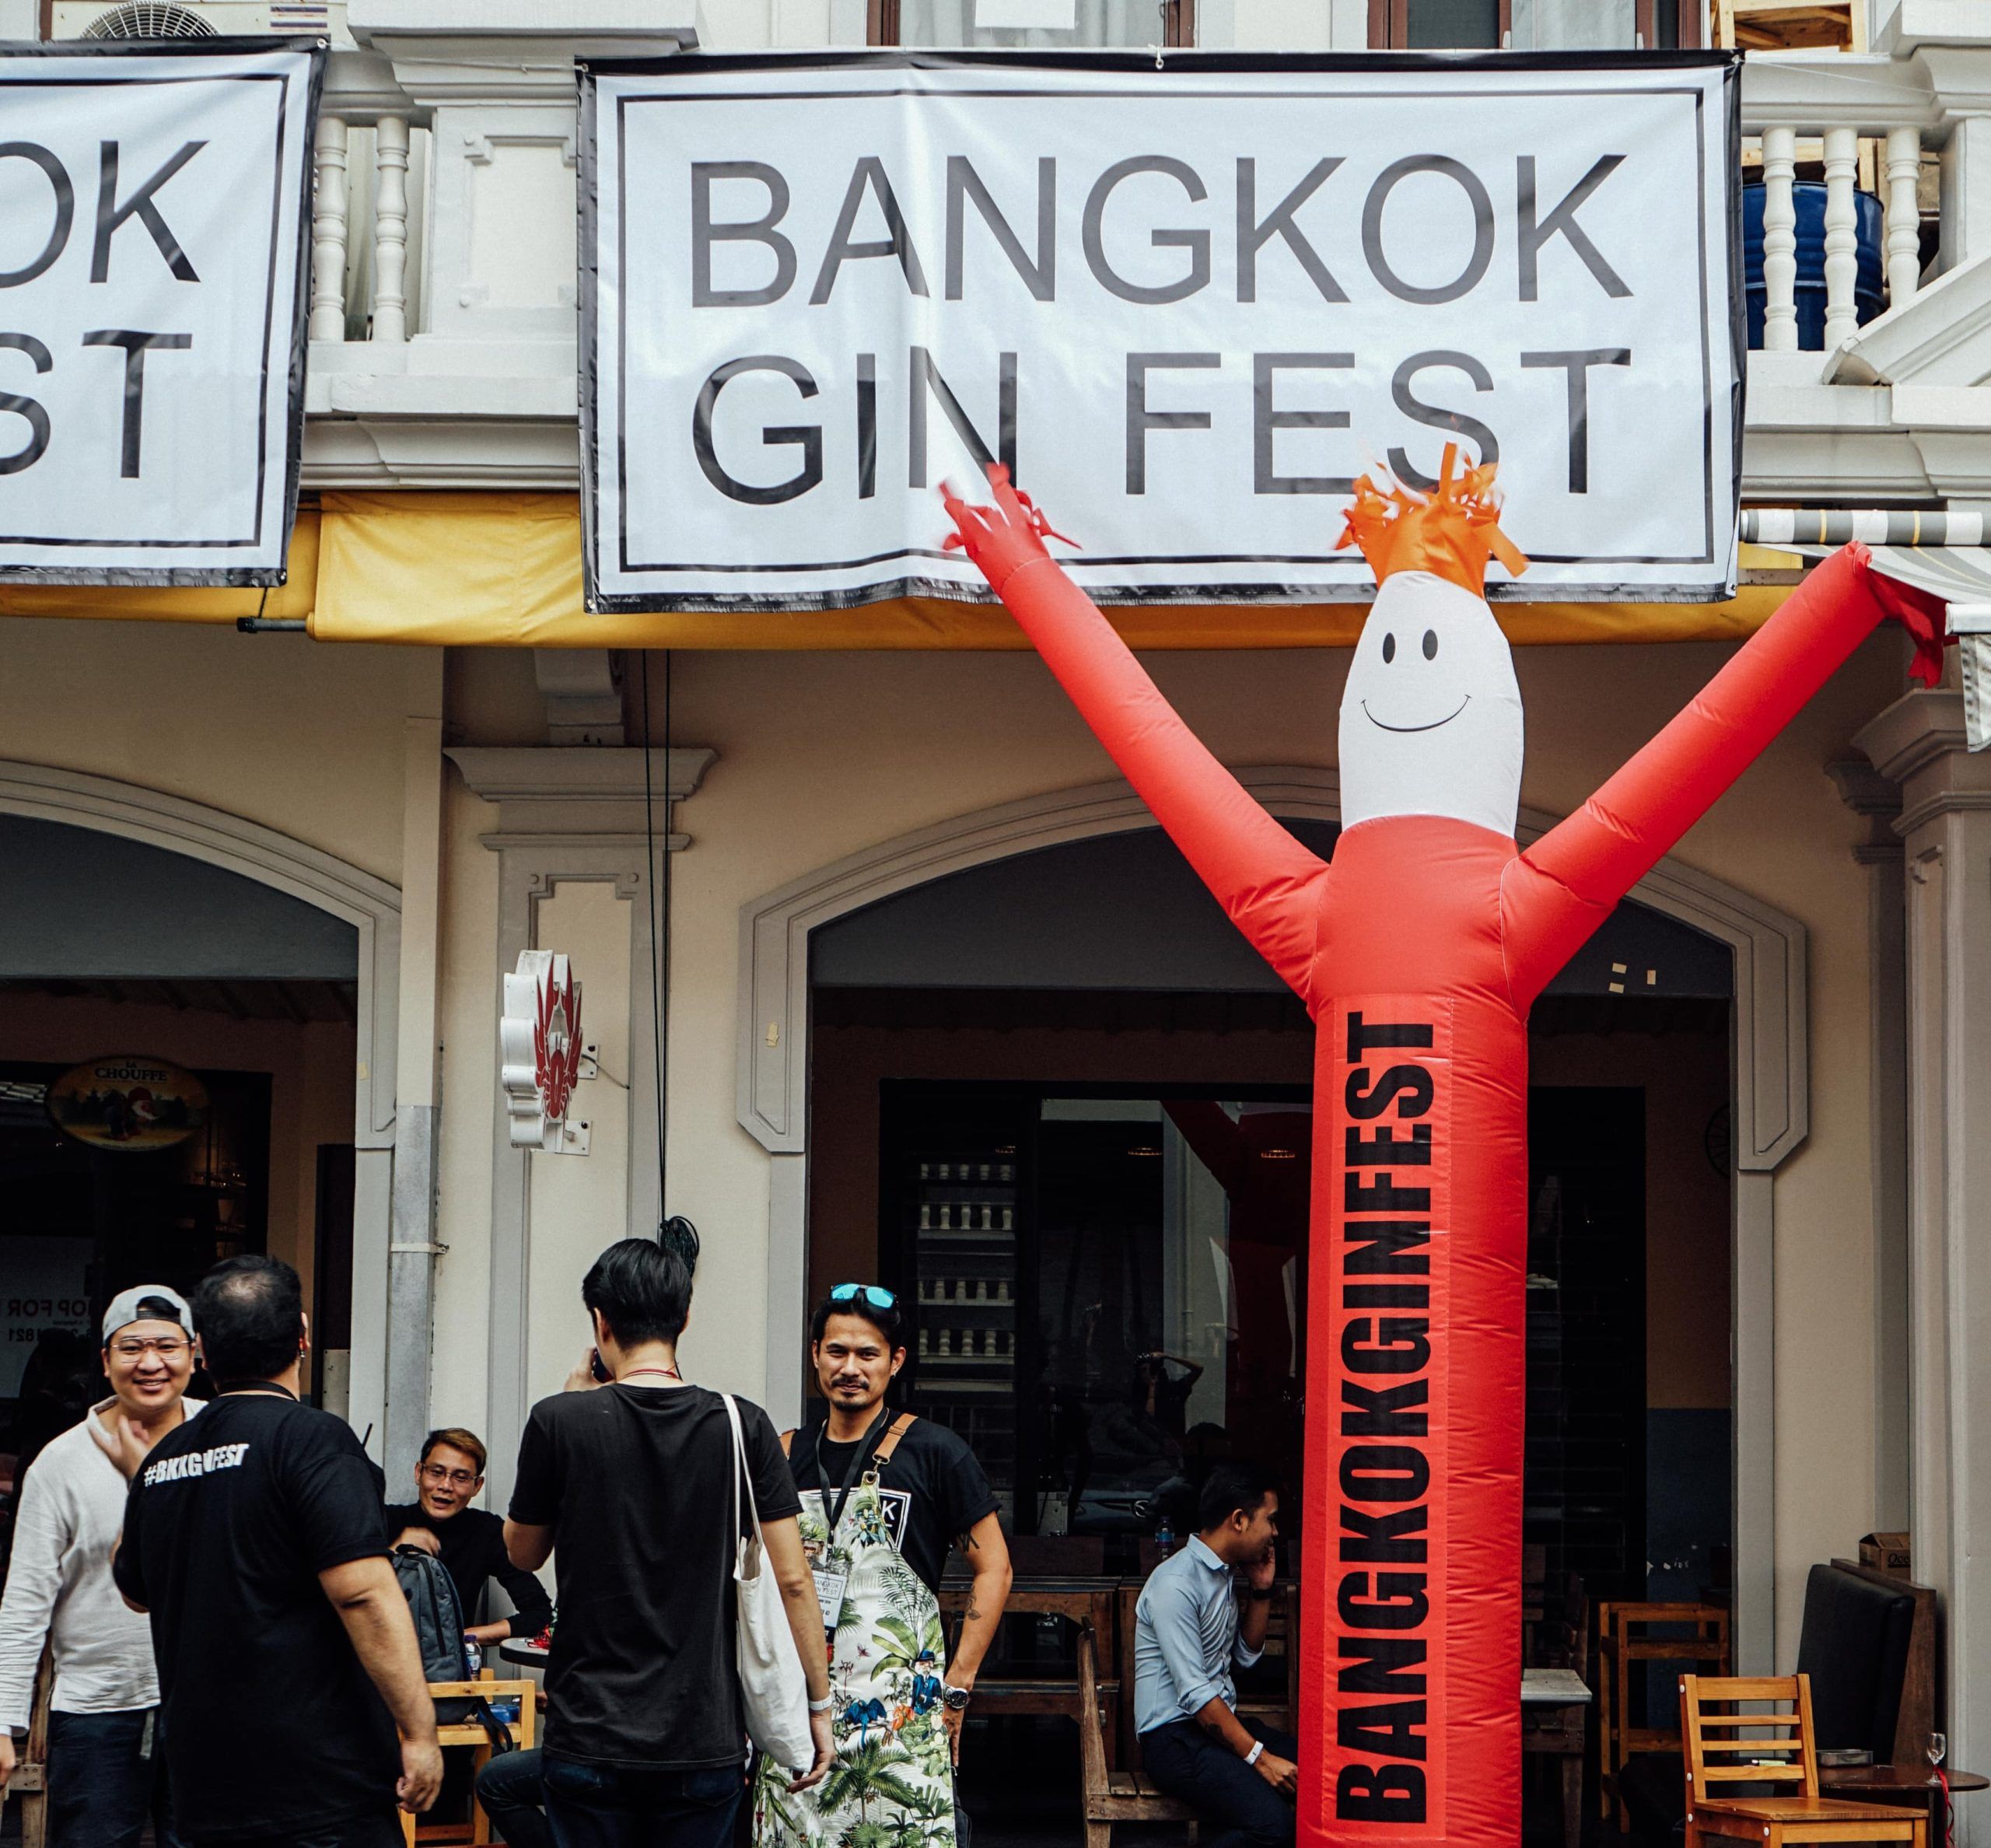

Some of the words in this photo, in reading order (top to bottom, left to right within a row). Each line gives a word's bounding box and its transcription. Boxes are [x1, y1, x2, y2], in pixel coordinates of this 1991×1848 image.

[691, 154, 1634, 307] BANGKOK
[692, 345, 1017, 506] GIN
[1125, 348, 1631, 495] FEST
[95, 1067, 167, 1081] CHOUFFE
[1336, 1011, 1434, 1824] BANGKOKGINFEST
